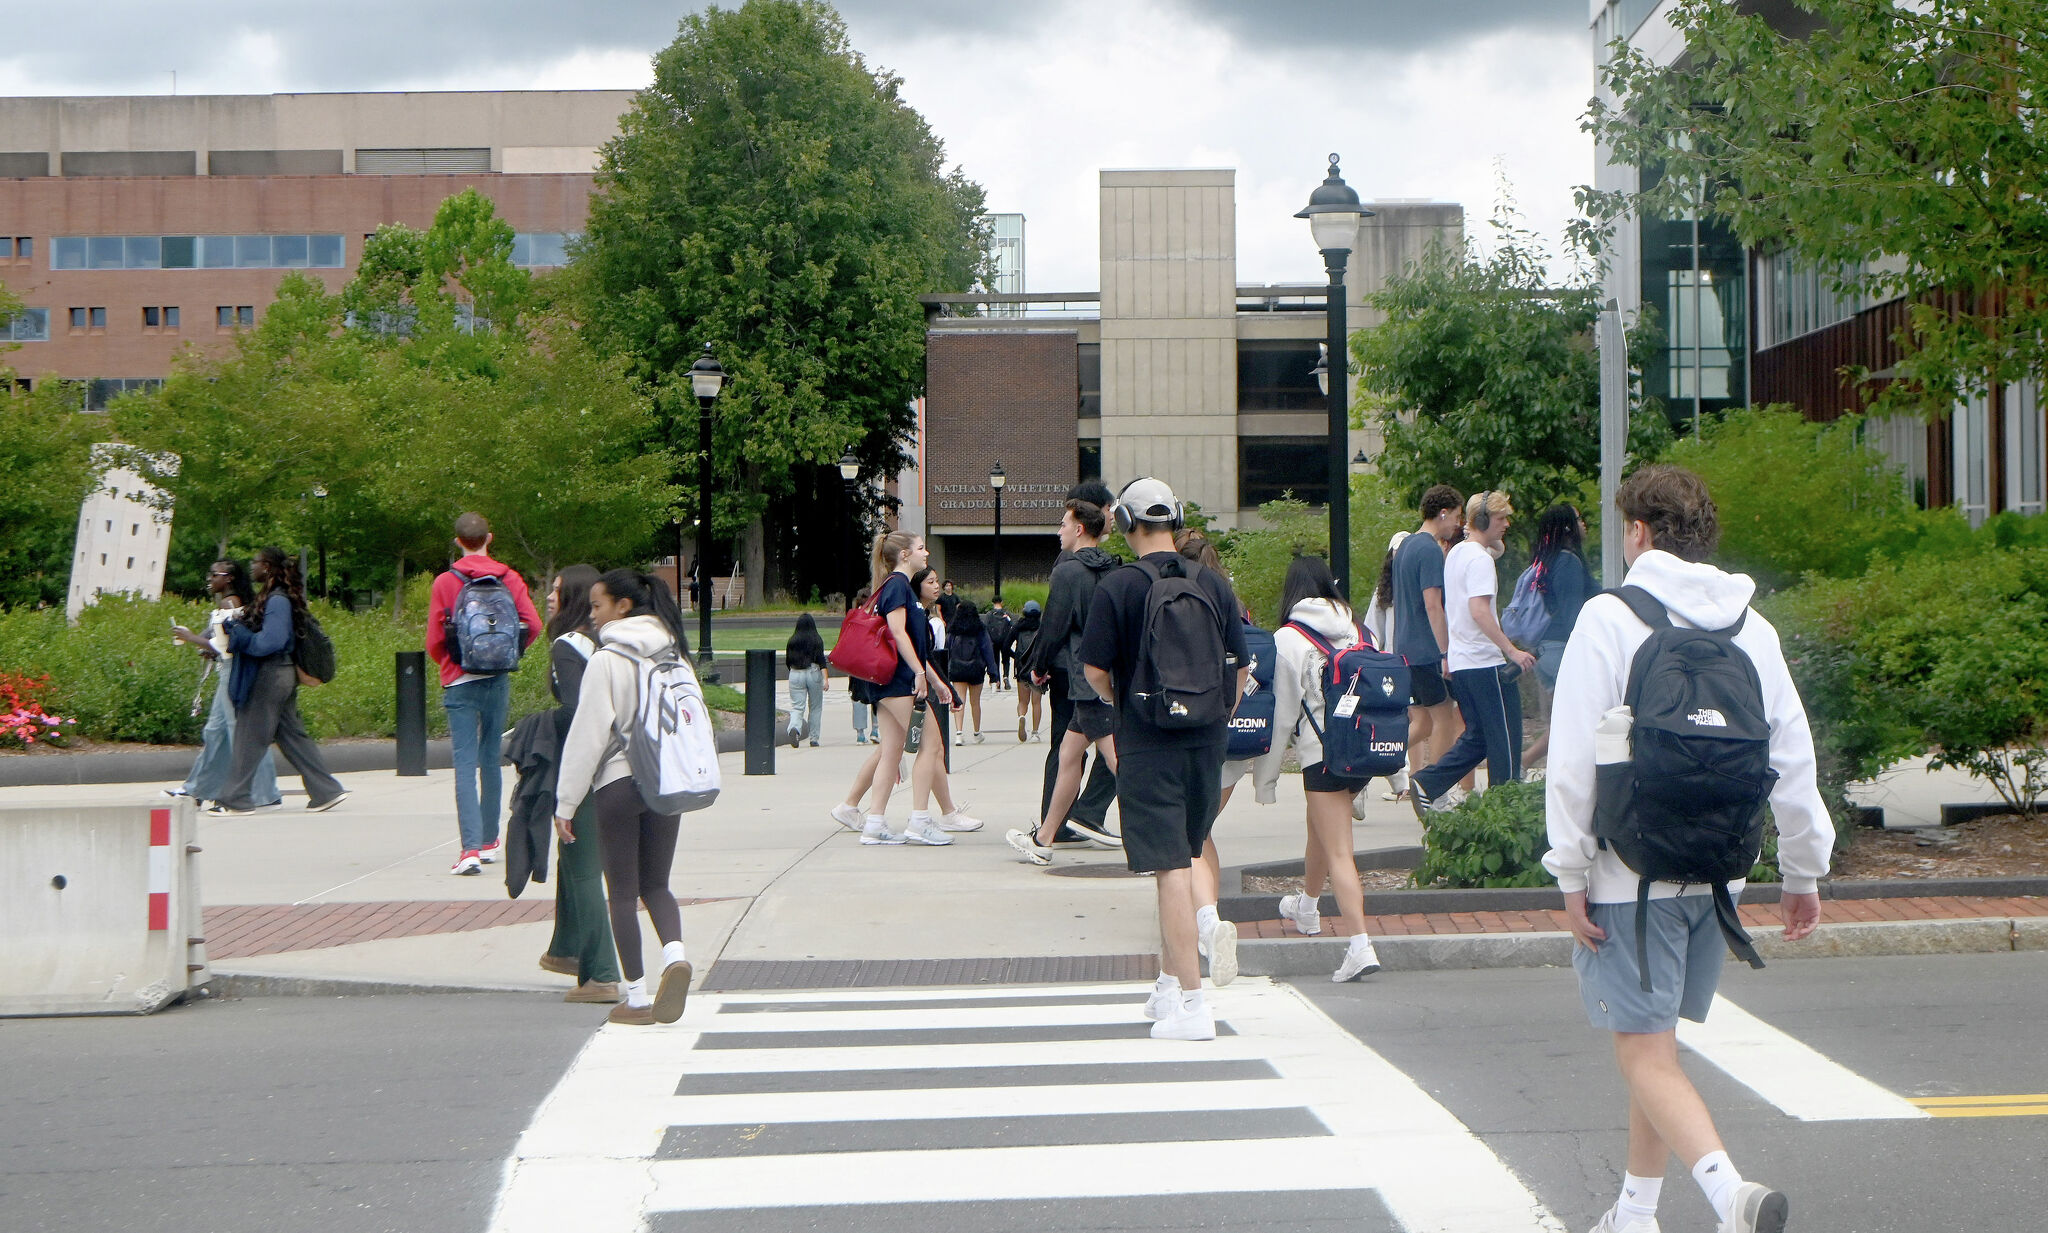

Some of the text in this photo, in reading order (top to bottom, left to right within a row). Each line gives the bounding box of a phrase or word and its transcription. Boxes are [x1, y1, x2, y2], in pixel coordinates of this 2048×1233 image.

[934, 485, 986, 493] NATHAN
[1007, 484, 1070, 493] WHETTEN
[1013, 499, 1065, 508] CENTER
[1370, 742, 1404, 751] UCONN
